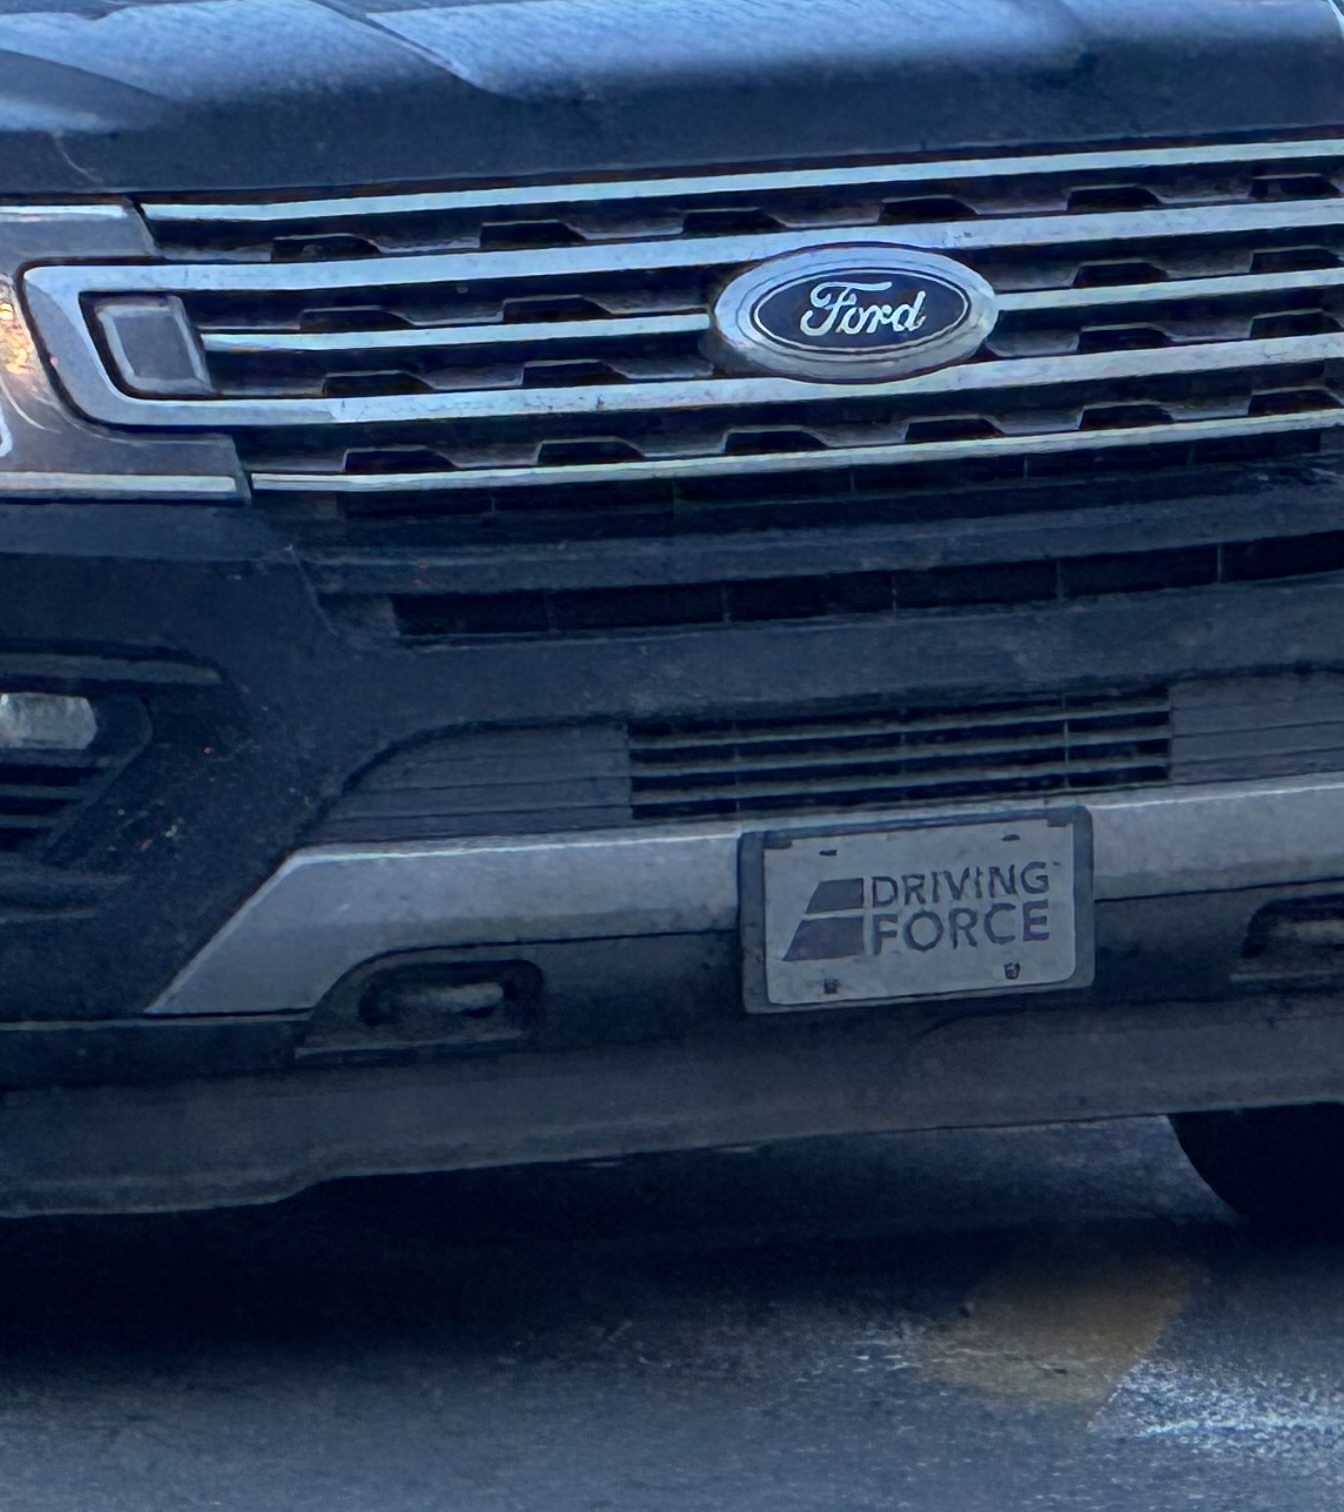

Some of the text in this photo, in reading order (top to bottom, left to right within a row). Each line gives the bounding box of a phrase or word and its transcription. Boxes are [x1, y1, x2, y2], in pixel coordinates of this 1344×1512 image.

[799, 281, 927, 336] Ford
[871, 861, 1050, 908] DRIVING
[872, 899, 1050, 955] FORCE
